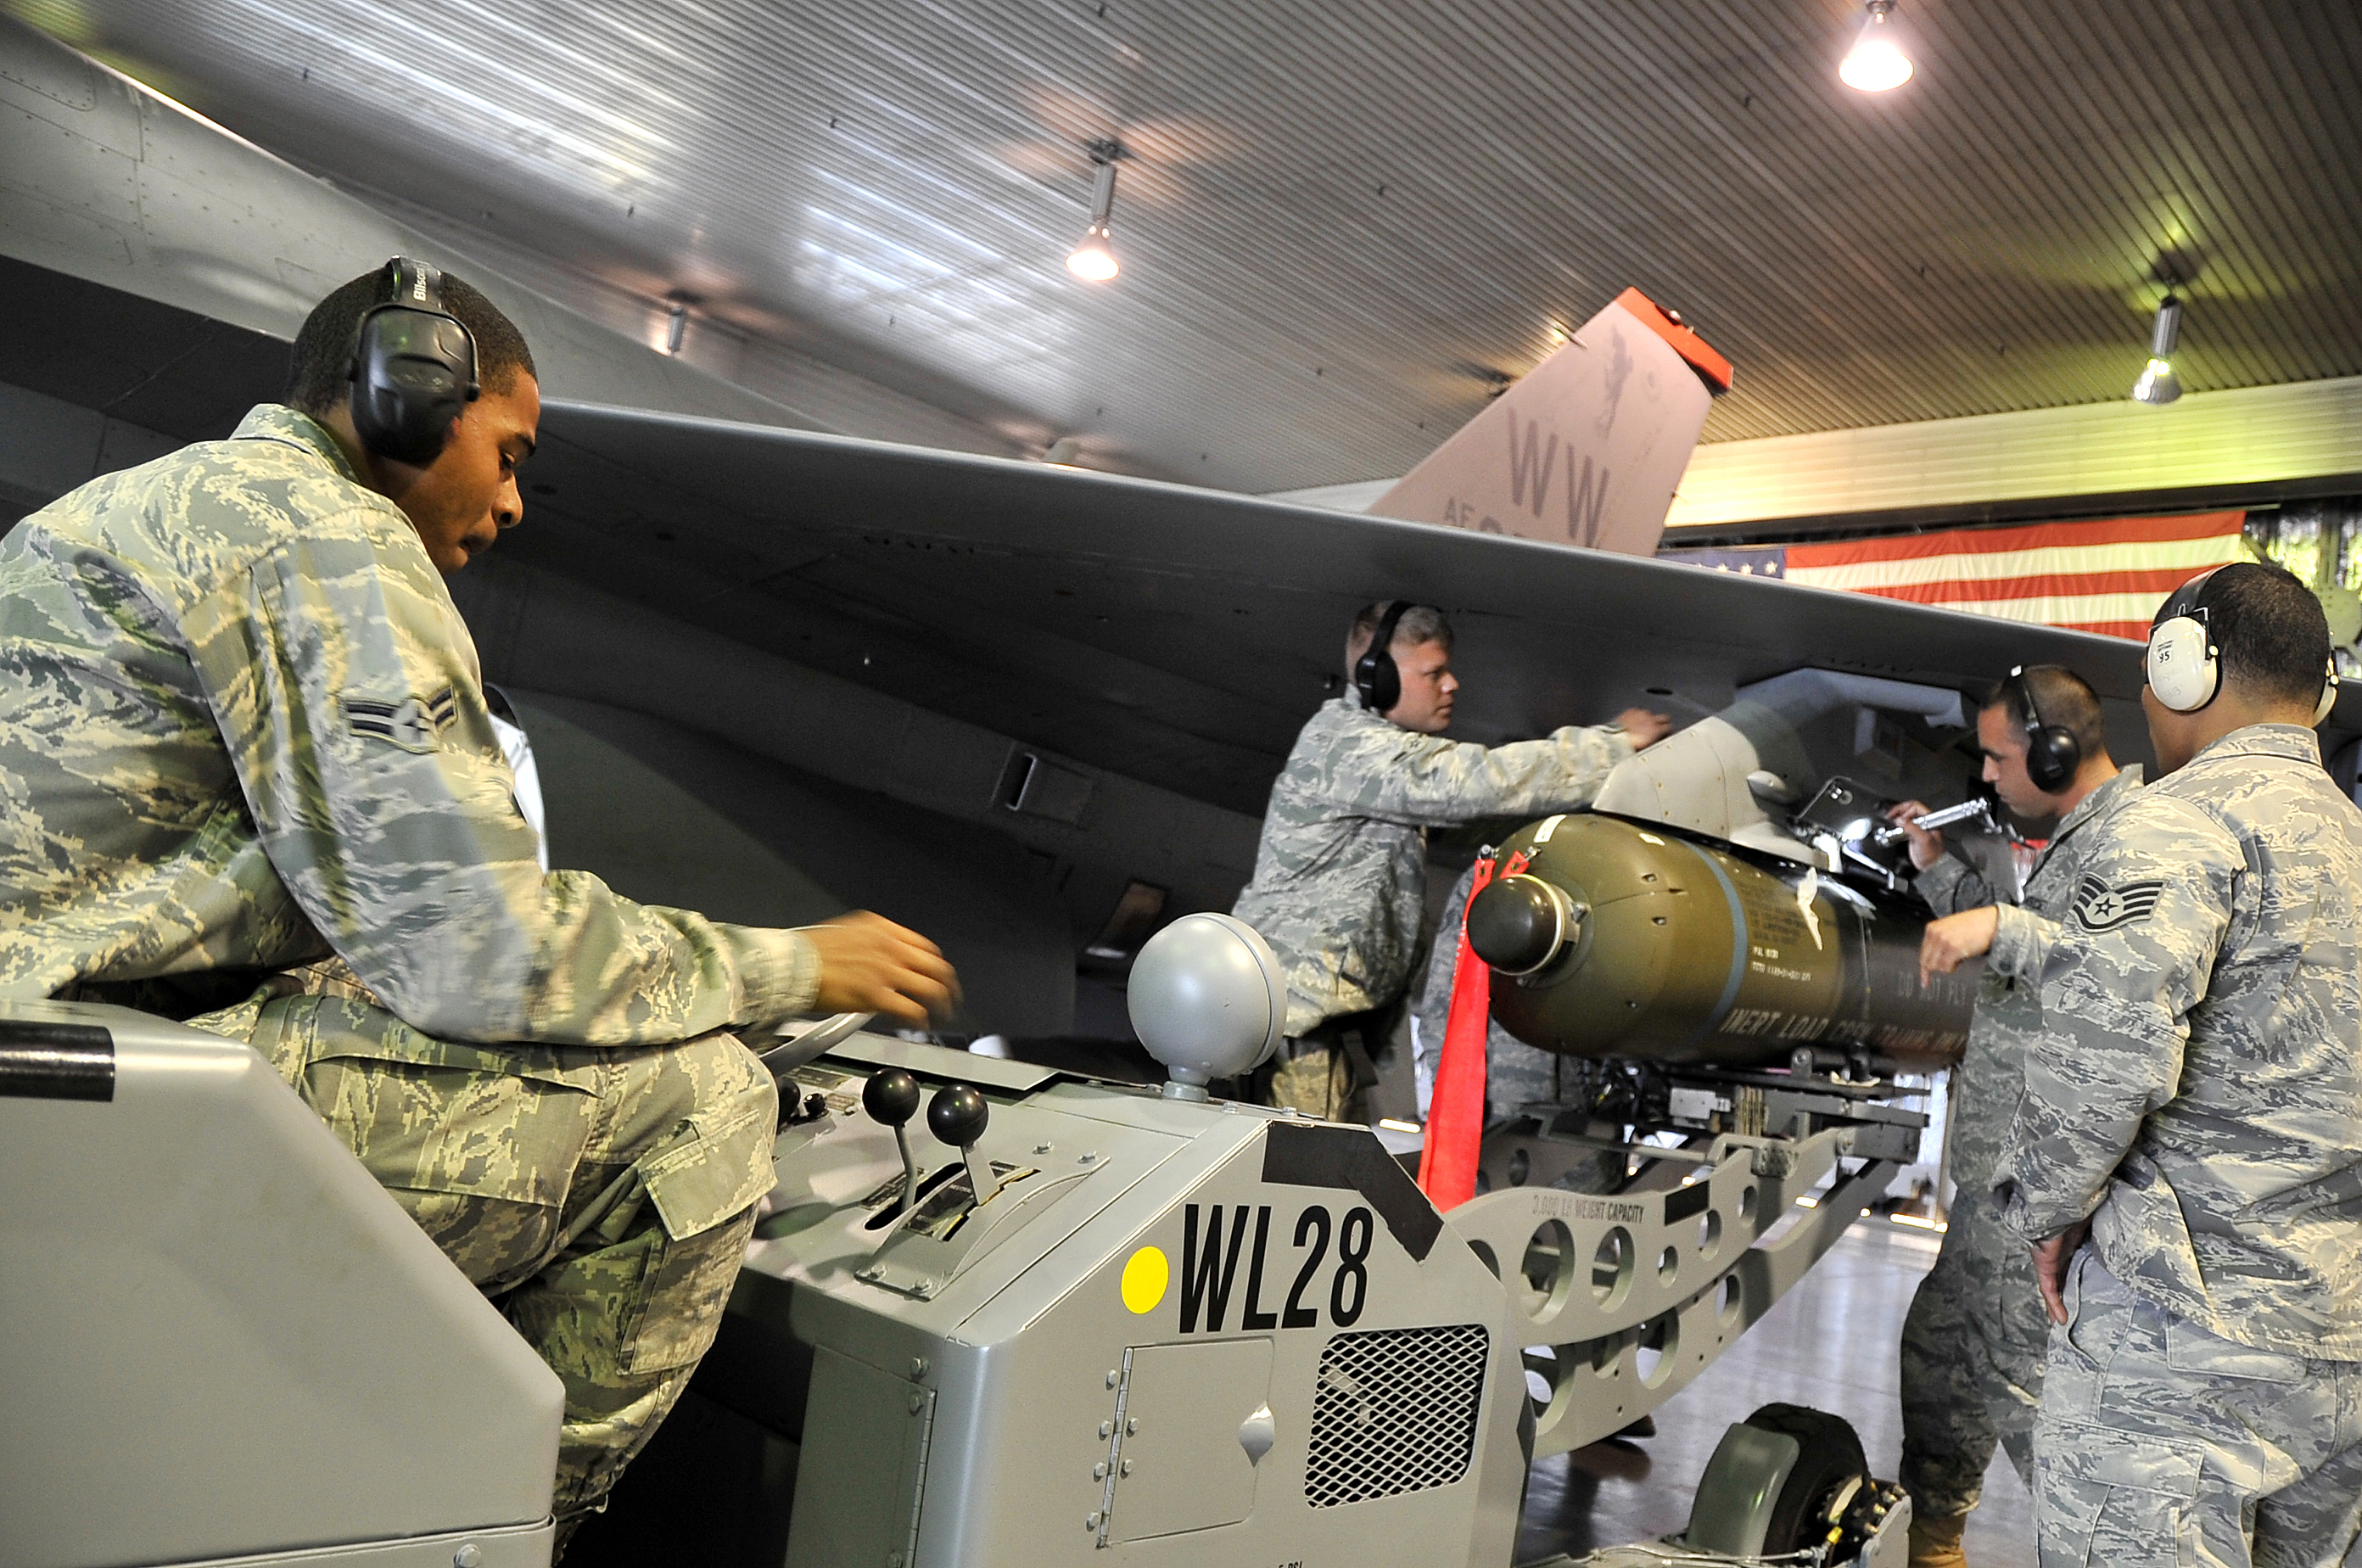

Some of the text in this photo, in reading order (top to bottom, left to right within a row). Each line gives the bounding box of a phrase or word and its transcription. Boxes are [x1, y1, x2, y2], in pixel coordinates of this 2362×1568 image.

[1719, 1008, 1782, 1036] INERT
[1777, 1013, 1830, 1041] LOAD
[1576, 1200, 1607, 1220] WEIGHT
[1608, 1203, 1645, 1224] CAPACITY
[1179, 1203, 1374, 1334] WL28
